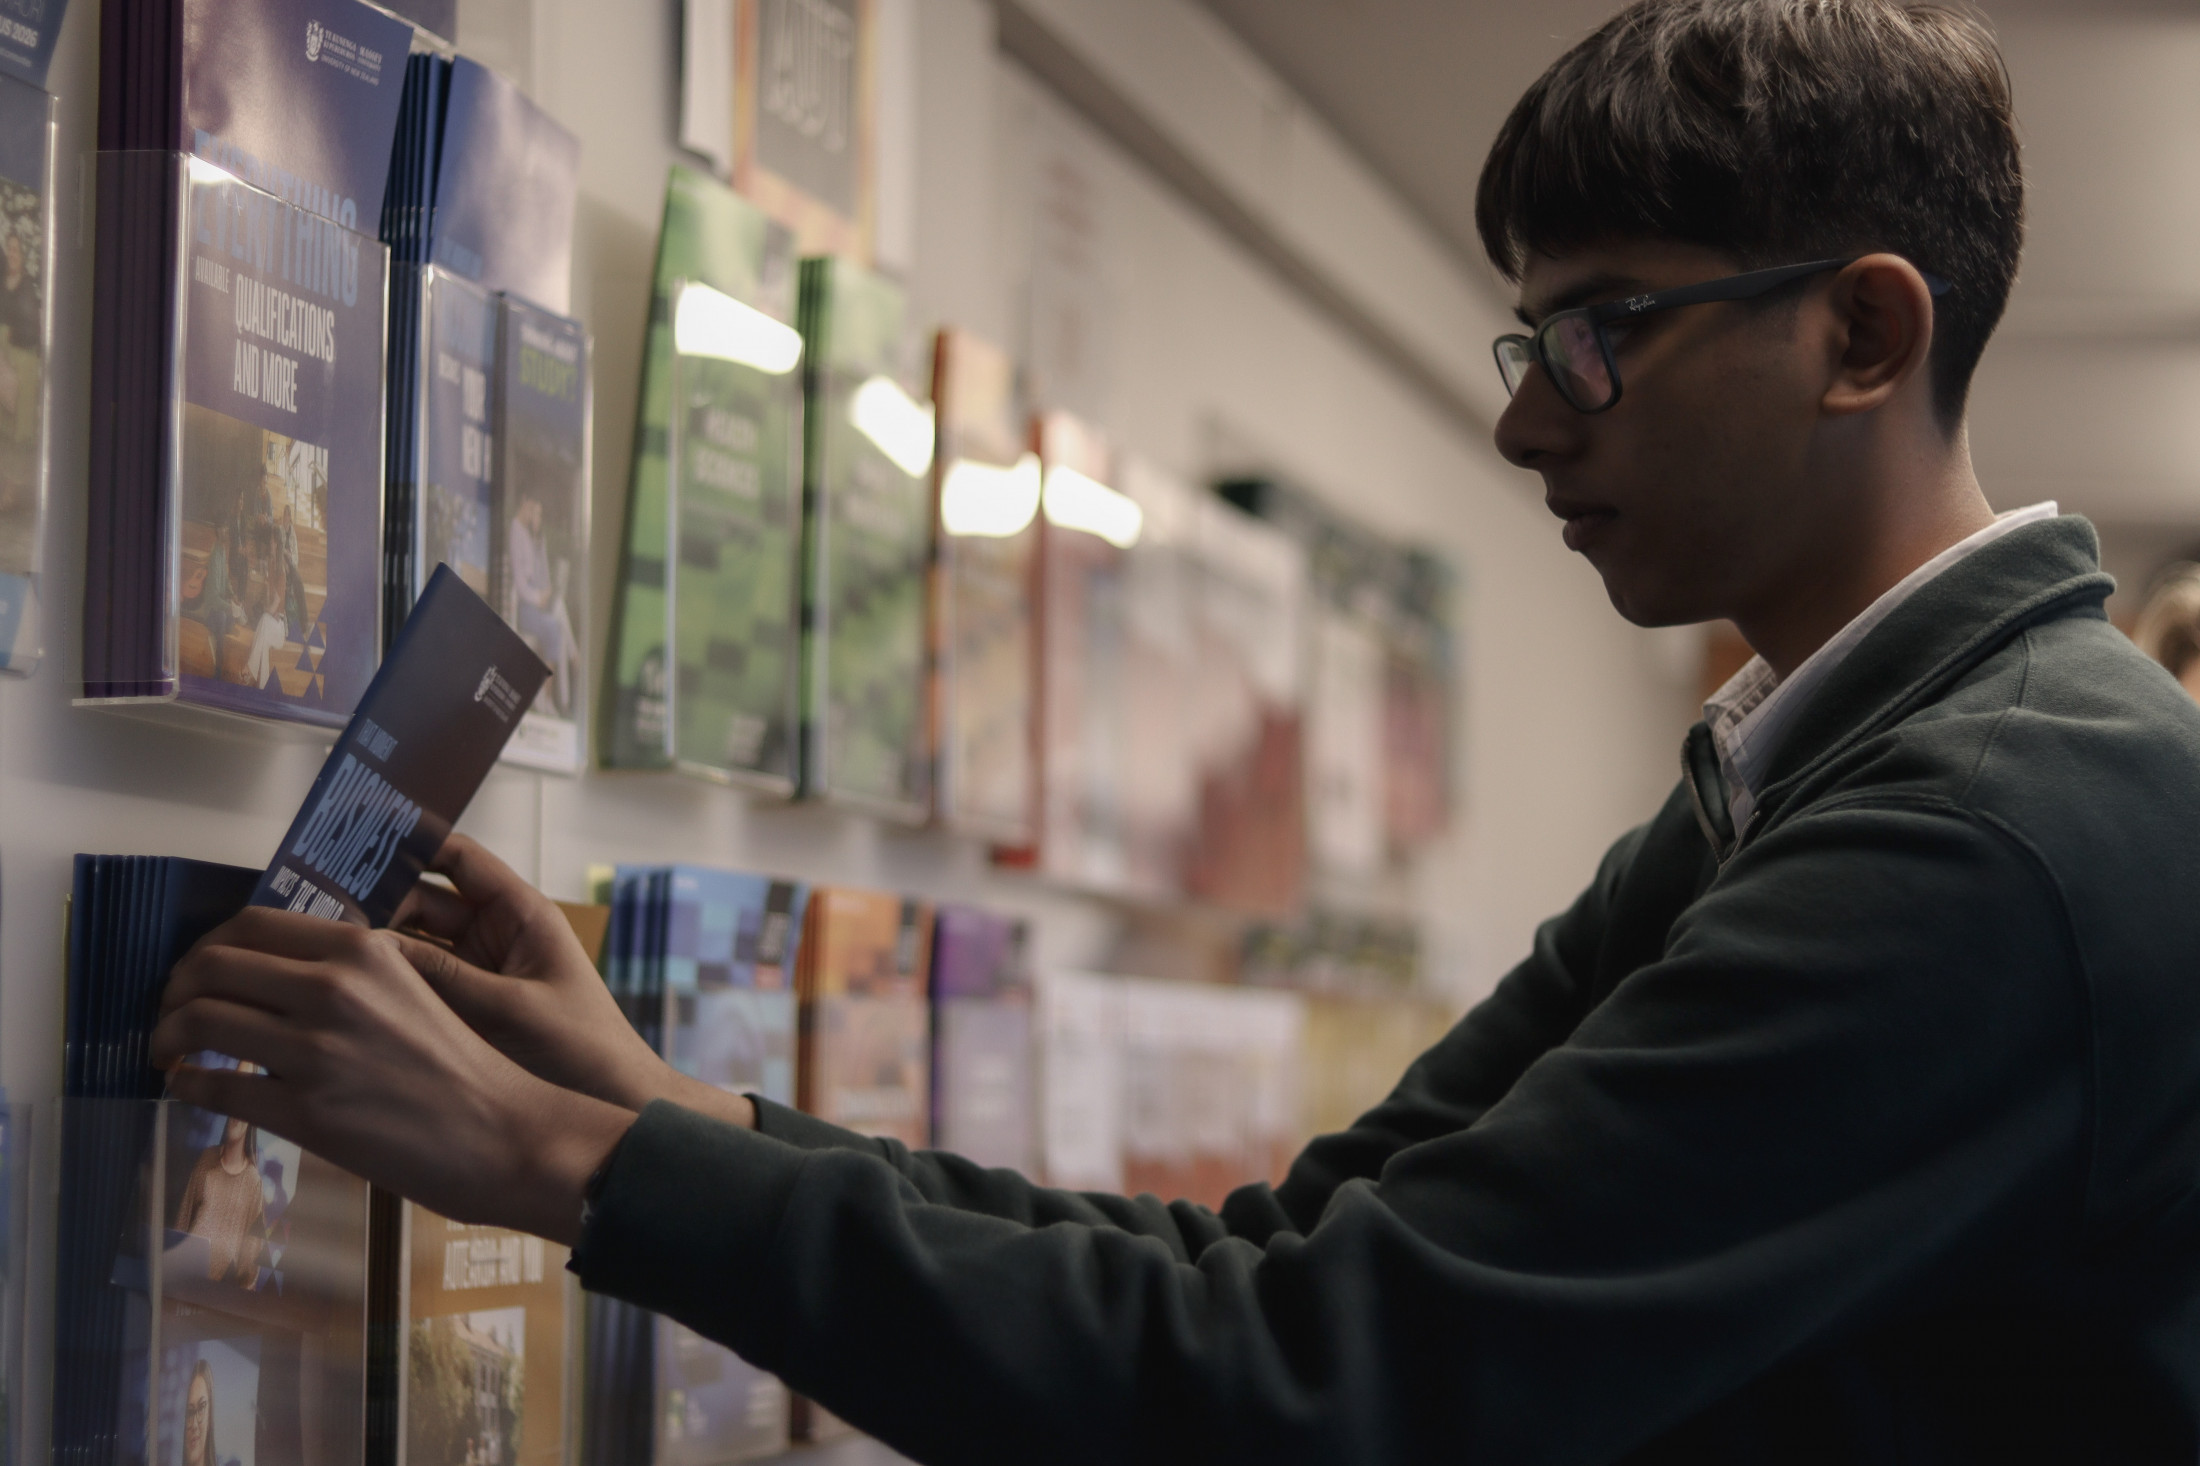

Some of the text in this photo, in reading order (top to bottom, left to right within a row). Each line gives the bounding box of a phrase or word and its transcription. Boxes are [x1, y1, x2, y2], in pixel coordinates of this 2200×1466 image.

[12, 22, 38, 48] 2026
[194, 128, 359, 309] EVERYTHING
[195, 256, 230, 294] AVAILABLE
[235, 273, 335, 363] QUALIFICATIONS
[233, 338, 298, 414] AND MORE
[291, 753, 422, 901] BUSINESS
[286, 880, 318, 912] THE
